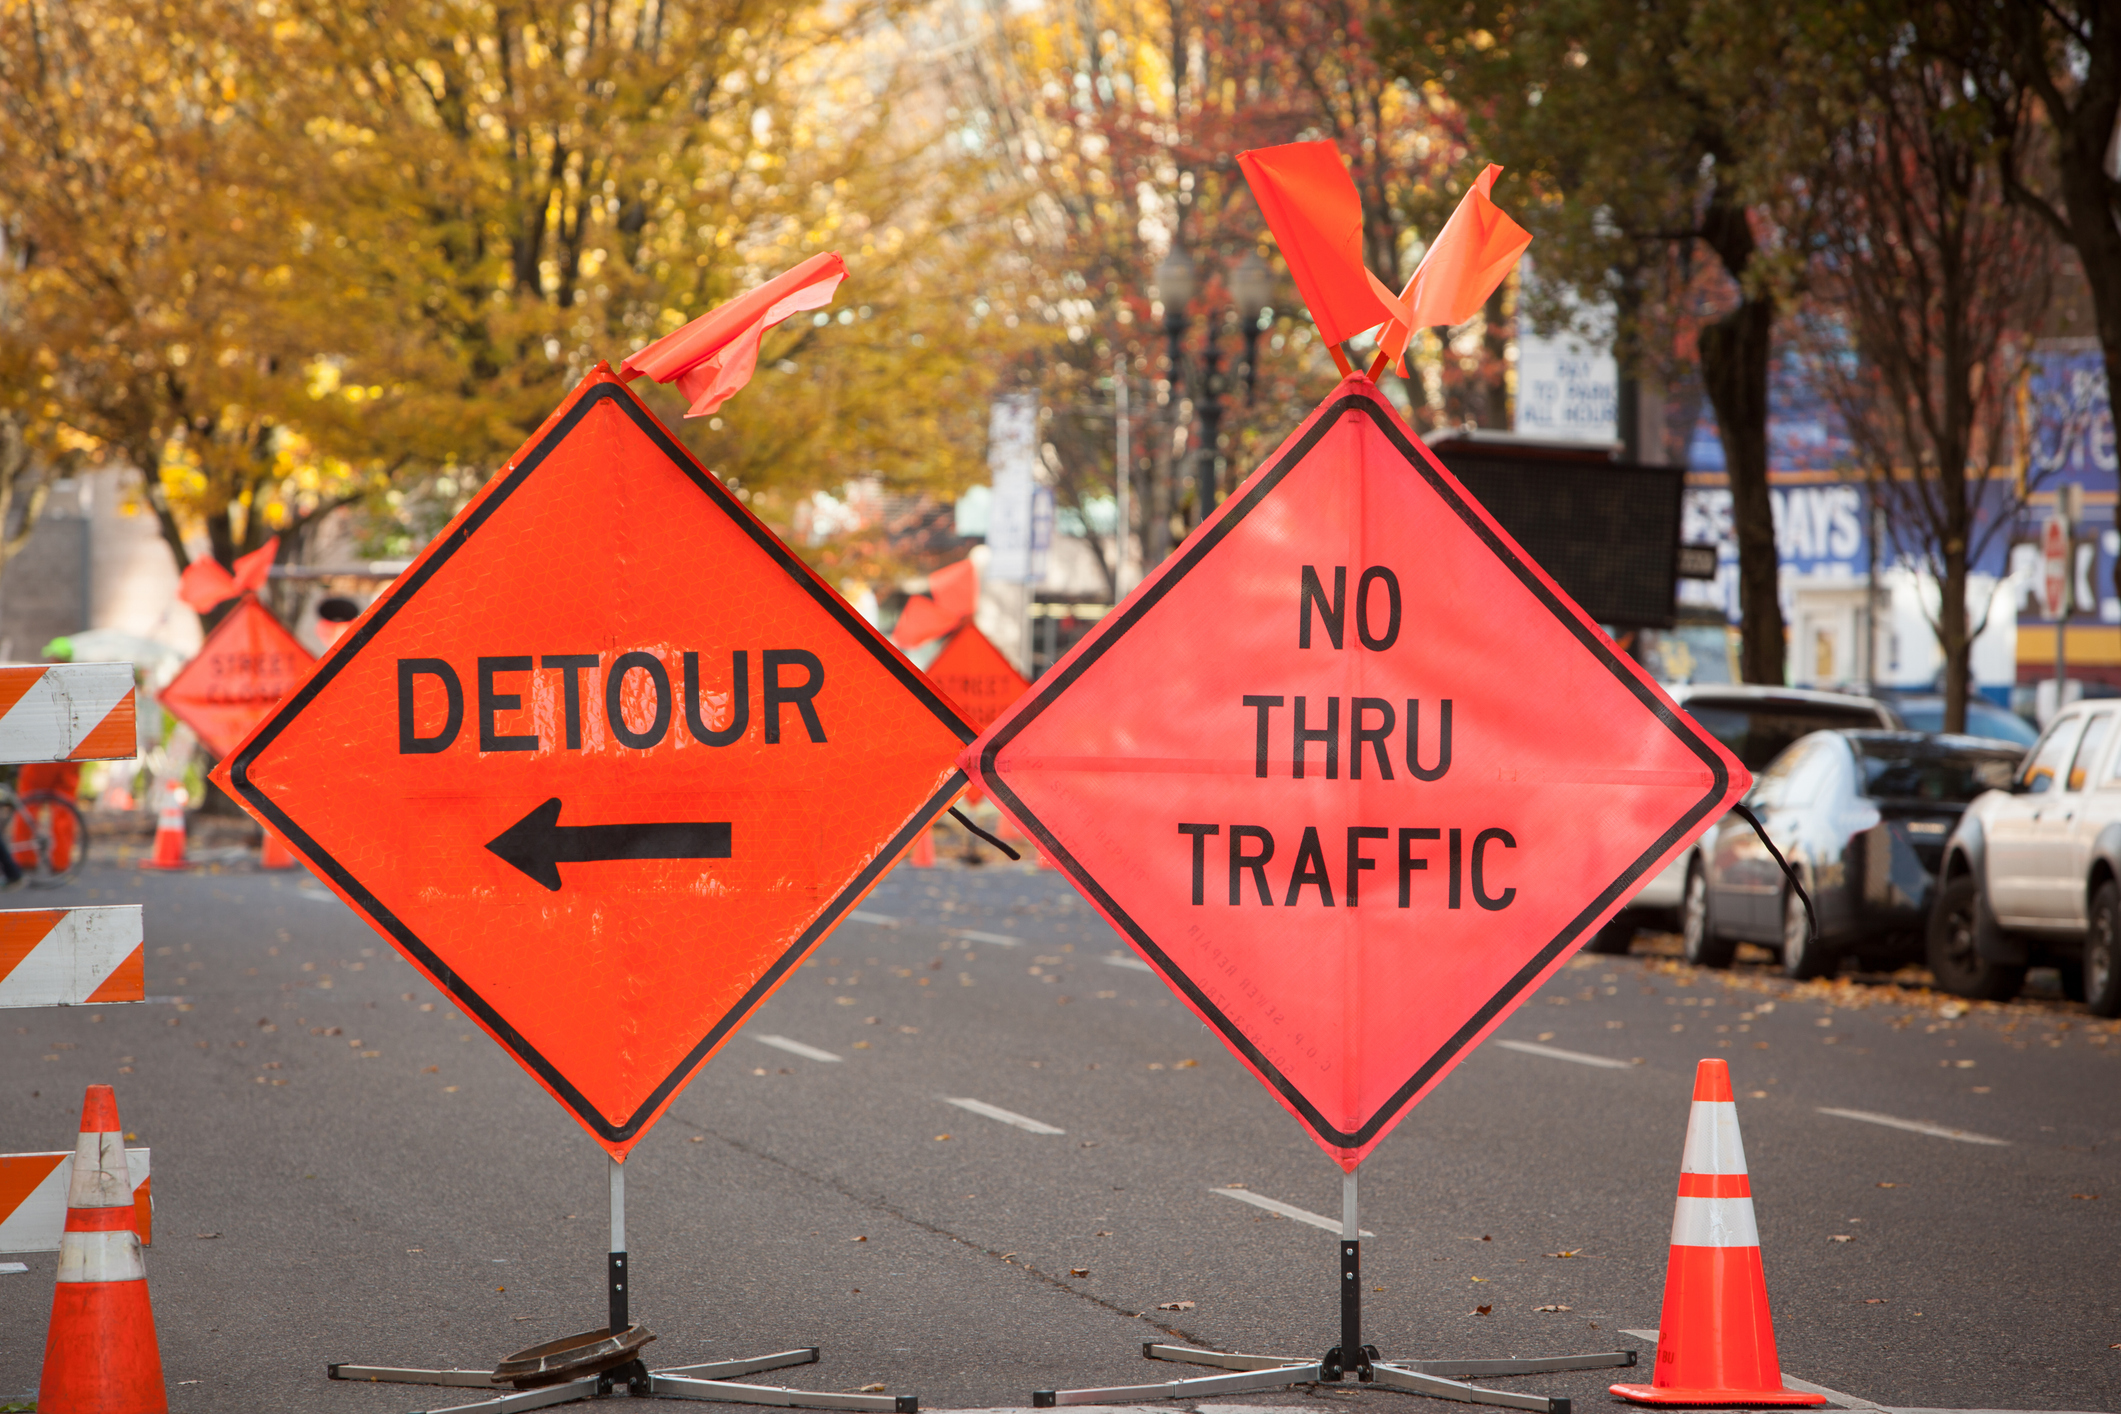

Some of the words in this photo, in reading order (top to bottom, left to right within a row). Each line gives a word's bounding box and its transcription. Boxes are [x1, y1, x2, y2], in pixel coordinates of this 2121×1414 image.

[1299, 565, 1402, 652] NO
[209, 652, 295, 678] STREET
[397, 649, 828, 754] DETOUR
[1242, 695, 1453, 782] THRU
[1178, 823, 1517, 912] TRAFFIC
